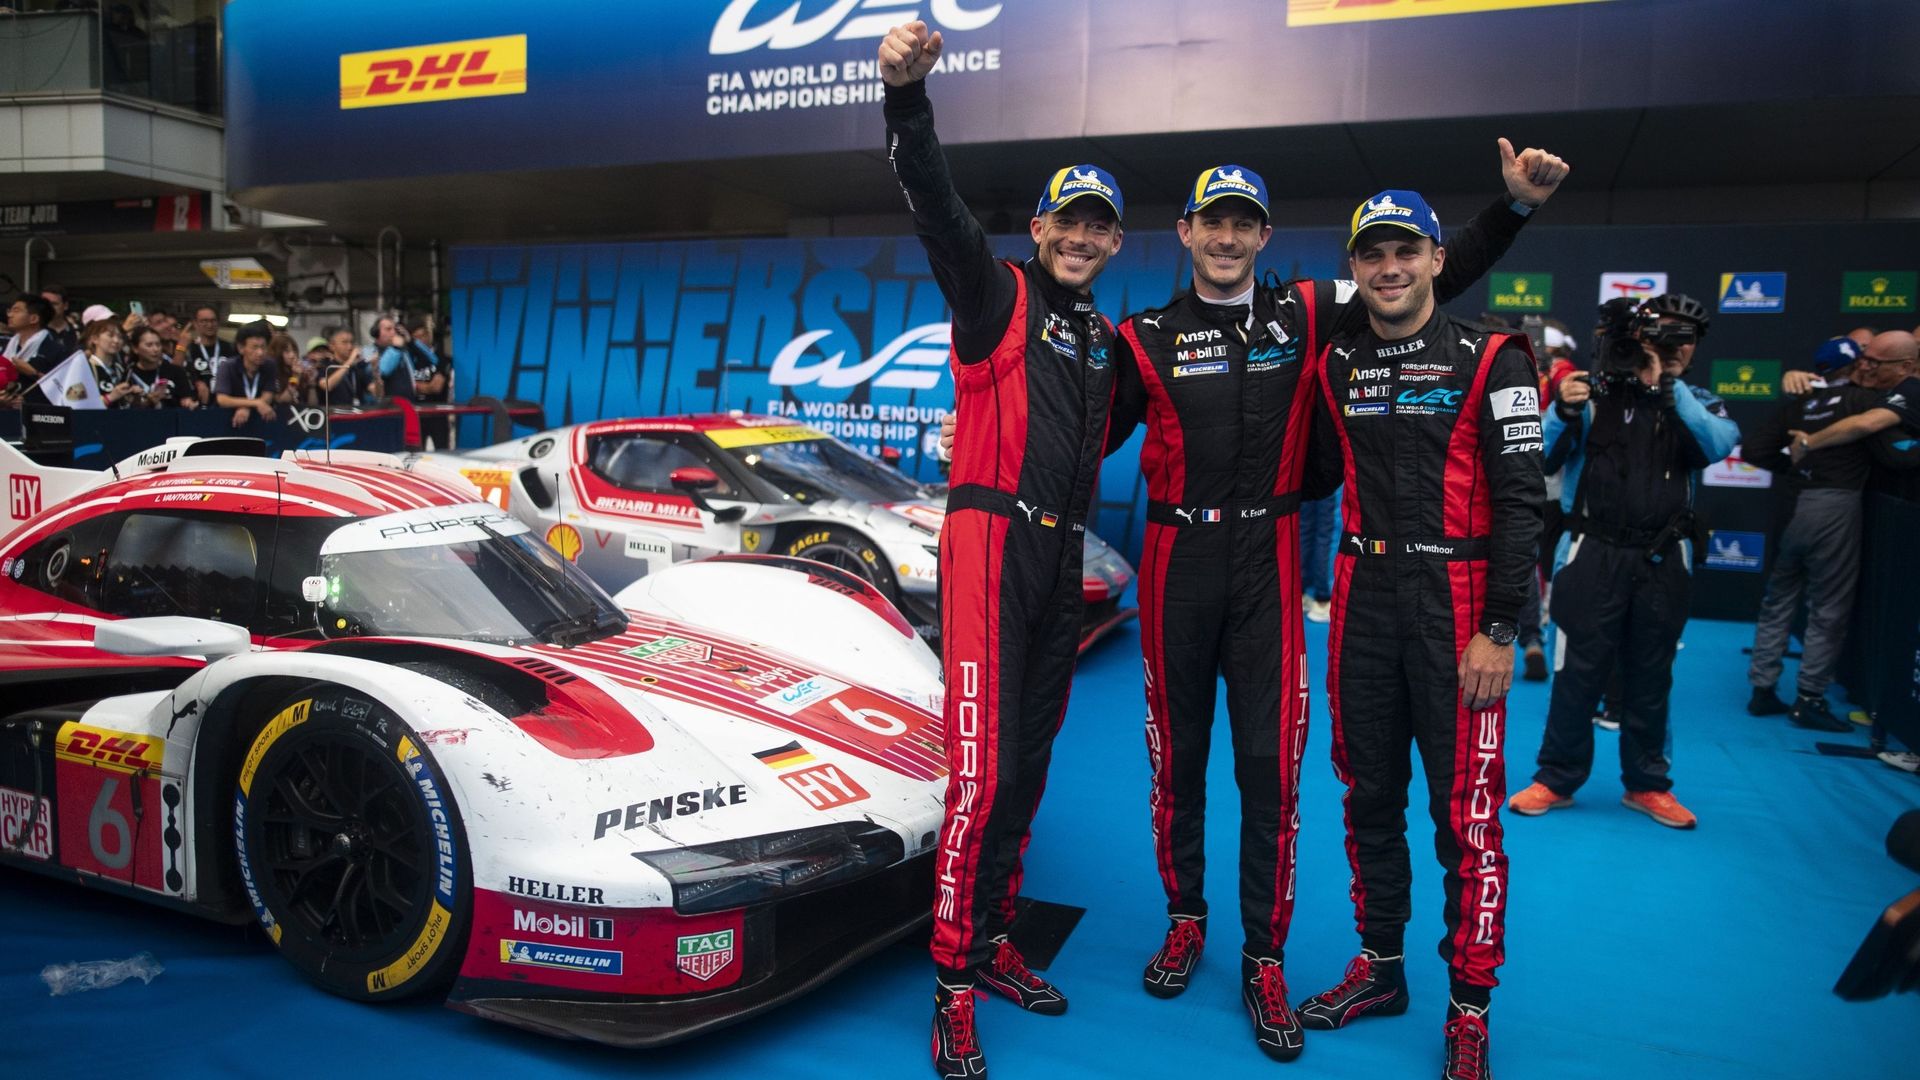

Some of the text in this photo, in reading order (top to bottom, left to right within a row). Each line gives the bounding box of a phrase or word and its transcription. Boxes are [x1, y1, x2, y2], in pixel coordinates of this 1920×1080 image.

[366, 50, 500, 96] DHL
[708, 49, 1001, 93] FIA WORLD ENANCE
[1062, 182, 1114, 197] MICHELIN
[1206, 182, 1259, 196] MICHELIN
[1494, 294, 1545, 307] ROLEX
[1849, 296, 1908, 307] ROLEX
[1175, 329, 1222, 345] Ansys
[1177, 347, 1212, 361] Mobil
[1376, 339, 1426, 358] HELLER
[1188, 365, 1224, 373] MICHELIN
[1349, 367, 1391, 382] Ansys
[1401, 363, 1453, 372] PORSCHE PENSKE
[1399, 374, 1441, 382] MOTORSPORT
[1349, 386, 1378, 400] Mobil
[1396, 388, 1463, 406] WEC
[1717, 382, 1771, 396] ROLEX
[768, 400, 798, 416] FIA
[802, 402, 874, 420] WORLD
[1356, 405, 1386, 413] MICHELIN
[137, 452, 166, 467] Mobil
[11, 478, 39, 518] HY
[162, 493, 202, 502] VANTHOOR
[596, 496, 699, 519] RICHARD MILLE
[1241, 509, 1249, 518] K.
[629, 541, 666, 554] HELLER
[789, 531, 831, 557] EAGLE
[1414, 543, 1454, 555] Vanthoor
[633, 637, 687, 658] TAG
[733, 666, 793, 691] Ansys
[782, 680, 821, 702] WEC
[828, 698, 908, 737] 6
[66, 730, 151, 769] DHL
[785, 766, 858, 807] HY
[938, 661, 979, 920] PORSCHE
[593, 784, 748, 840] PENSKE
[88, 777, 132, 870] 6
[1467, 711, 1502, 945] PORSCHE
[418, 778, 453, 897] MICHELIN
[235, 798, 263, 908] MICHELIN
[508, 875, 606, 905] HELLER
[513, 909, 584, 938] Mobil
[407, 913, 443, 970] PILOT SPORT
[683, 934, 729, 953] TAG
[534, 950, 611, 968] MICHELIN
[680, 952, 731, 977] HEUER
